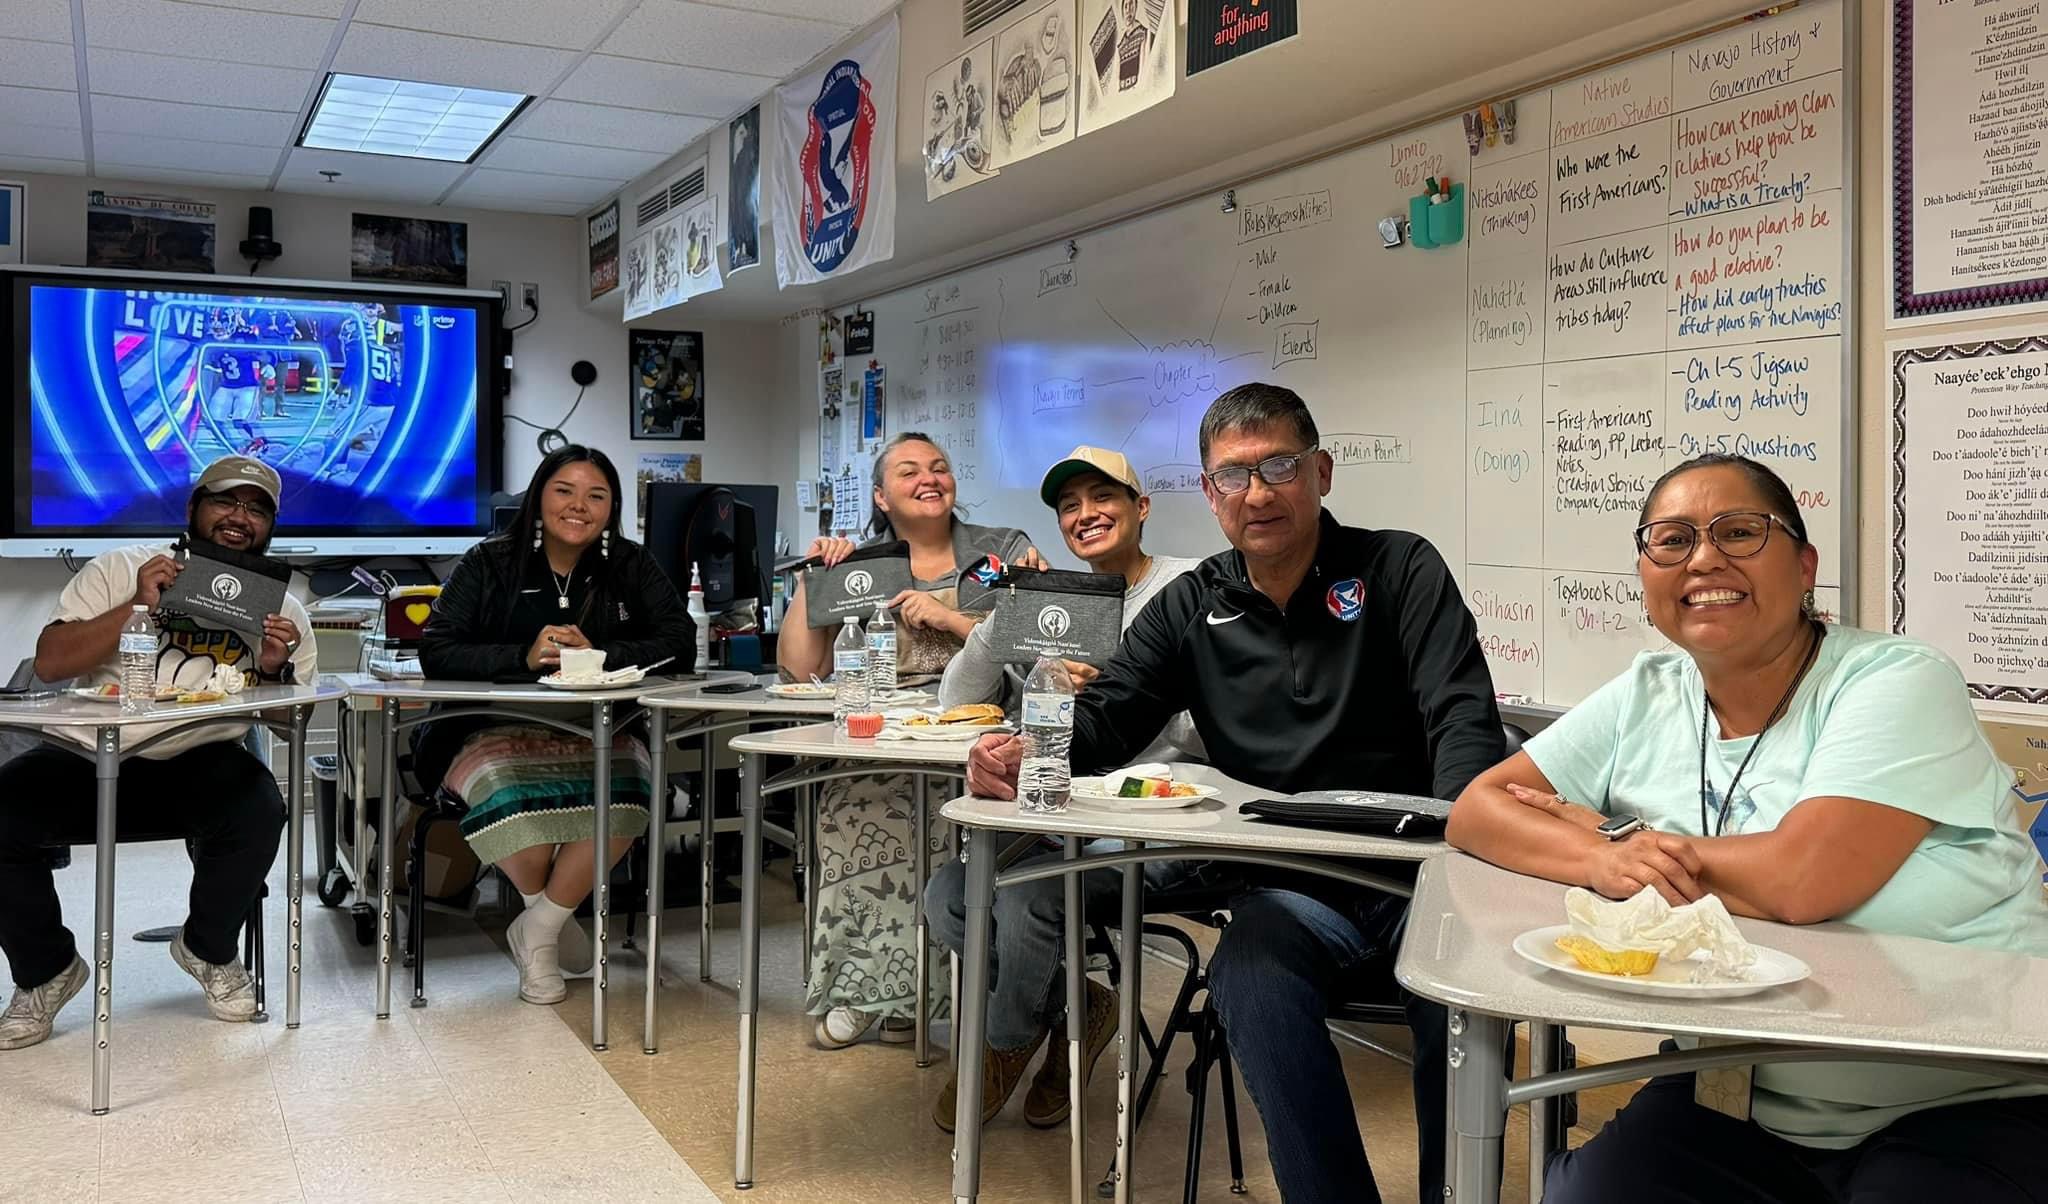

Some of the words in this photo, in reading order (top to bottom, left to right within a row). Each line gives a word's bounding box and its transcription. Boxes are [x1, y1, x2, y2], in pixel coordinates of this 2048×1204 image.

[1214, 10, 1269, 46] anything
[1221, 4, 1240, 26] for
[1688, 43, 1741, 74] Navajo
[1751, 30, 1802, 61] History
[1583, 77, 1631, 105] Native
[1709, 59, 1796, 101] Government
[1554, 111, 1617, 147] American
[1620, 95, 1670, 127] Studies
[2003, 105, 2018, 117] baa
[1677, 117, 1708, 150] How
[1390, 140, 1427, 168] Lumio
[1556, 155, 1578, 181] Who
[1585, 152, 1611, 173] were
[1615, 144, 1640, 165] the
[1675, 148, 1732, 179] relatives
[1735, 135, 1764, 160] help
[1767, 130, 1794, 160] you
[1801, 119, 1816, 139] be
[1394, 154, 1443, 190] 962792
[1694, 159, 1769, 200] successful?
[1560, 185, 1591, 213] First
[1592, 164, 1668, 208] Americans?
[1727, 193, 1738, 209] is
[1739, 193, 1751, 206] a
[1481, 204, 1536, 236] (Thinking)
[1674, 227, 1701, 257] How
[1707, 225, 1724, 248] do
[1728, 223, 1753, 255] you
[1755, 215, 1789, 246] plan
[1791, 206, 1805, 231] to
[1810, 203, 1830, 227] be
[1950, 223, 1994, 240] Hanaanish
[1956, 241, 2000, 257] Hanaanish
[2002, 239, 2017, 250] baa
[1550, 253, 1576, 281] How
[1580, 252, 1594, 273] do
[1599, 245, 1655, 270] Culture
[1675, 275, 1683, 292] a
[1690, 257, 1718, 298] good
[1723, 244, 1783, 280] relative?
[1554, 283, 1585, 303] Areas
[1586, 276, 1607, 295] still
[1608, 269, 1668, 293] influence
[1713, 288, 1734, 310] did
[1740, 283, 1775, 312] early
[1775, 272, 1827, 301] treaties
[124, 299, 204, 338] LOVE
[1472, 312, 1533, 346] (Planning)
[1556, 307, 1589, 332] tribes
[1592, 300, 1632, 333] today?
[1678, 315, 1714, 337] affect
[1716, 313, 1745, 336] plans
[1749, 310, 1765, 329] for
[1769, 308, 1791, 327] the
[1282, 329, 1314, 356] Events
[221, 353, 240, 379] 3
[371, 349, 392, 383] 51
[1154, 360, 1193, 390] Chapter
[1715, 355, 1743, 378] 1-5
[1750, 352, 1809, 387] Jigsaw
[1685, 387, 1742, 421] Reading
[1750, 383, 1809, 416] Activity
[1967, 407, 1988, 418] Doo
[1587, 404, 1653, 431] Americans
[1735, 433, 1817, 461] Questions
[1957, 429, 1977, 440] Doo
[1343, 441, 1371, 462] Main
[1474, 446, 1530, 483] (Doing)
[1556, 455, 1585, 476] Notes
[1933, 450, 1953, 461] Doo
[1963, 469, 1984, 481] Doo
[1966, 490, 1986, 500] Doo
[1946, 511, 1966, 521] Doo
[1960, 531, 1980, 542] Doo
[1553, 576, 1613, 604] Textbook
[1934, 572, 1953, 582] Doo
[1472, 590, 1534, 621] Siihasin
[1602, 611, 1627, 632] 1-2
[1968, 632, 1989, 643] Doo
